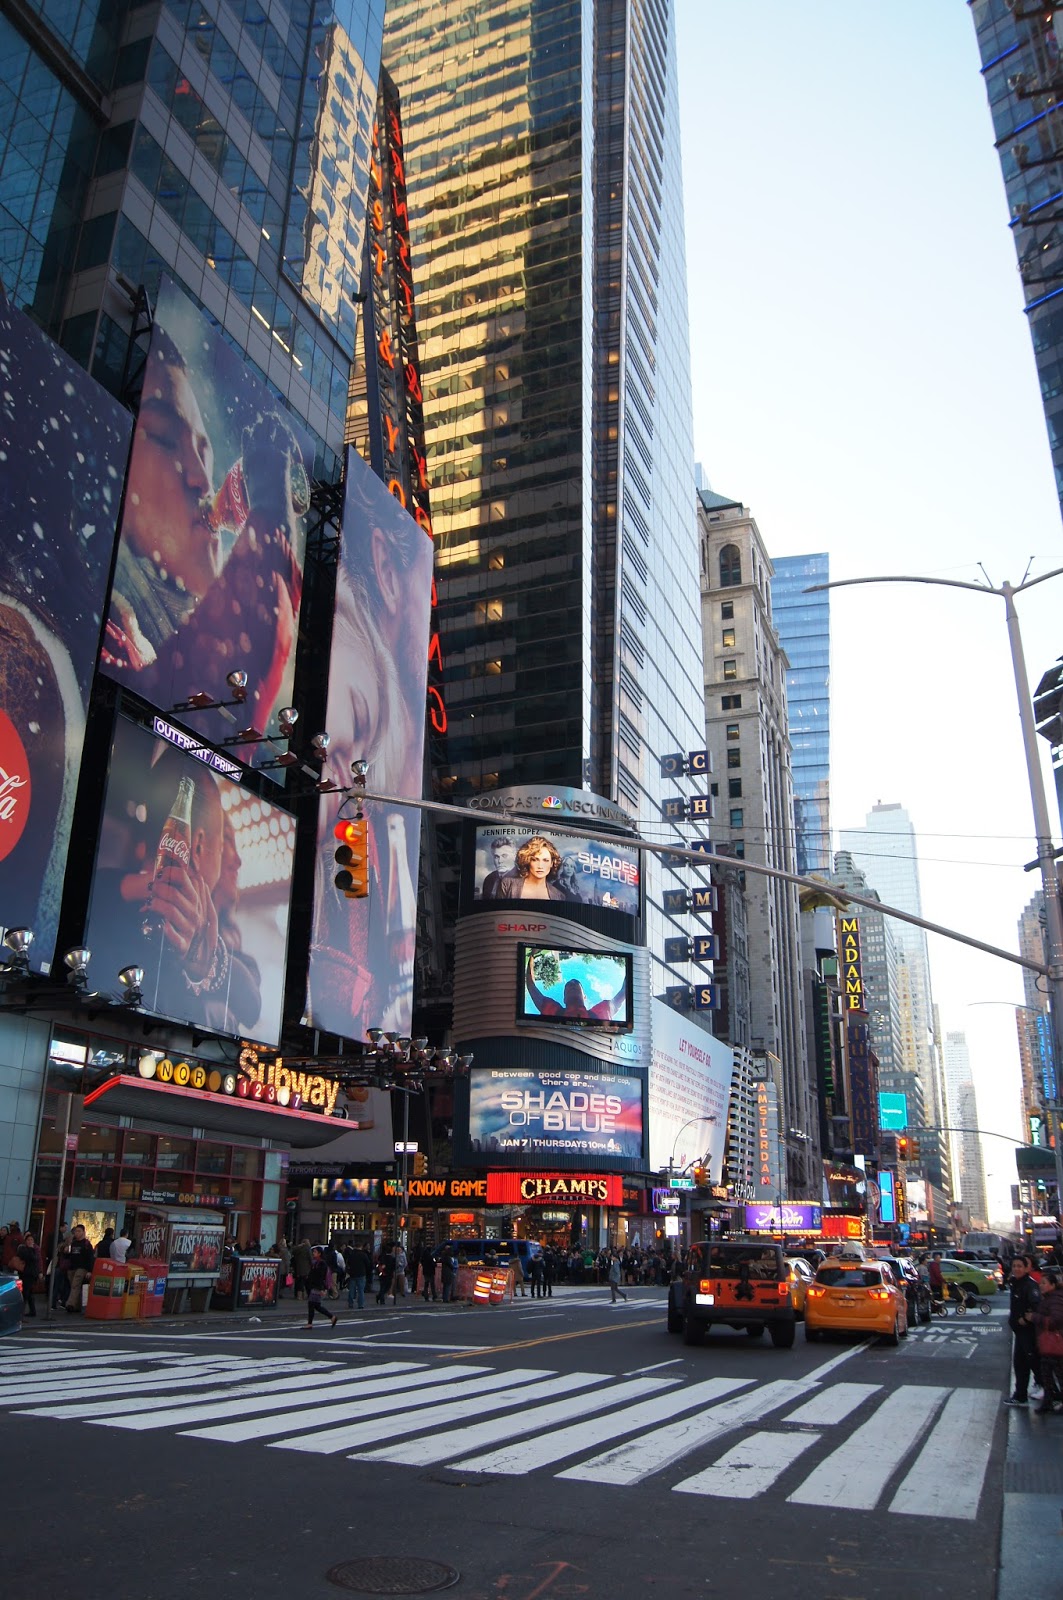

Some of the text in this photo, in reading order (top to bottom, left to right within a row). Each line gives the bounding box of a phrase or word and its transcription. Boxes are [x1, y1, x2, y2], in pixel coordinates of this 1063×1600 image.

[156, 720, 241, 779] OUTFRONT PRIME
[469, 796, 541, 809] COMCAST
[482, 828, 516, 836] JENNIFER
[518, 828, 540, 836] LOPEZ
[578, 852, 638, 876] SHADES
[582, 864, 635, 886] OF BLUE
[498, 924, 547, 932] SHARP
[842, 919, 862, 1009] MADAME
[613, 1041, 642, 1054] AQUOS
[679, 1038, 687, 1052] LET
[162, 1064, 300, 1107] N Q R S 1 2 3 7
[237, 1048, 340, 1116] Subway
[584, 1072, 599, 1081] and
[601, 1075, 616, 1083] bad
[617, 1078, 631, 1086] cop,
[501, 1090, 622, 1115] SHADES
[509, 1110, 616, 1134] OF BLUE
[758, 1083, 771, 1185] AMSTERDAM
[500, 1139, 521, 1147] JAN
[521, 1139, 529, 1147] 7
[533, 1139, 588, 1148] THURSDAYS
[408, 1180, 446, 1196] KNOW
[521, 1178, 608, 1200] CHAMPS
[734, 1183, 756, 1199] SEPHORA
[542, 1211, 570, 1221] CHAMPS
[755, 1207, 804, 1224] Aladdin
[142, 1227, 166, 1243] JERSEY
[171, 1234, 202, 1254] JERSEY
